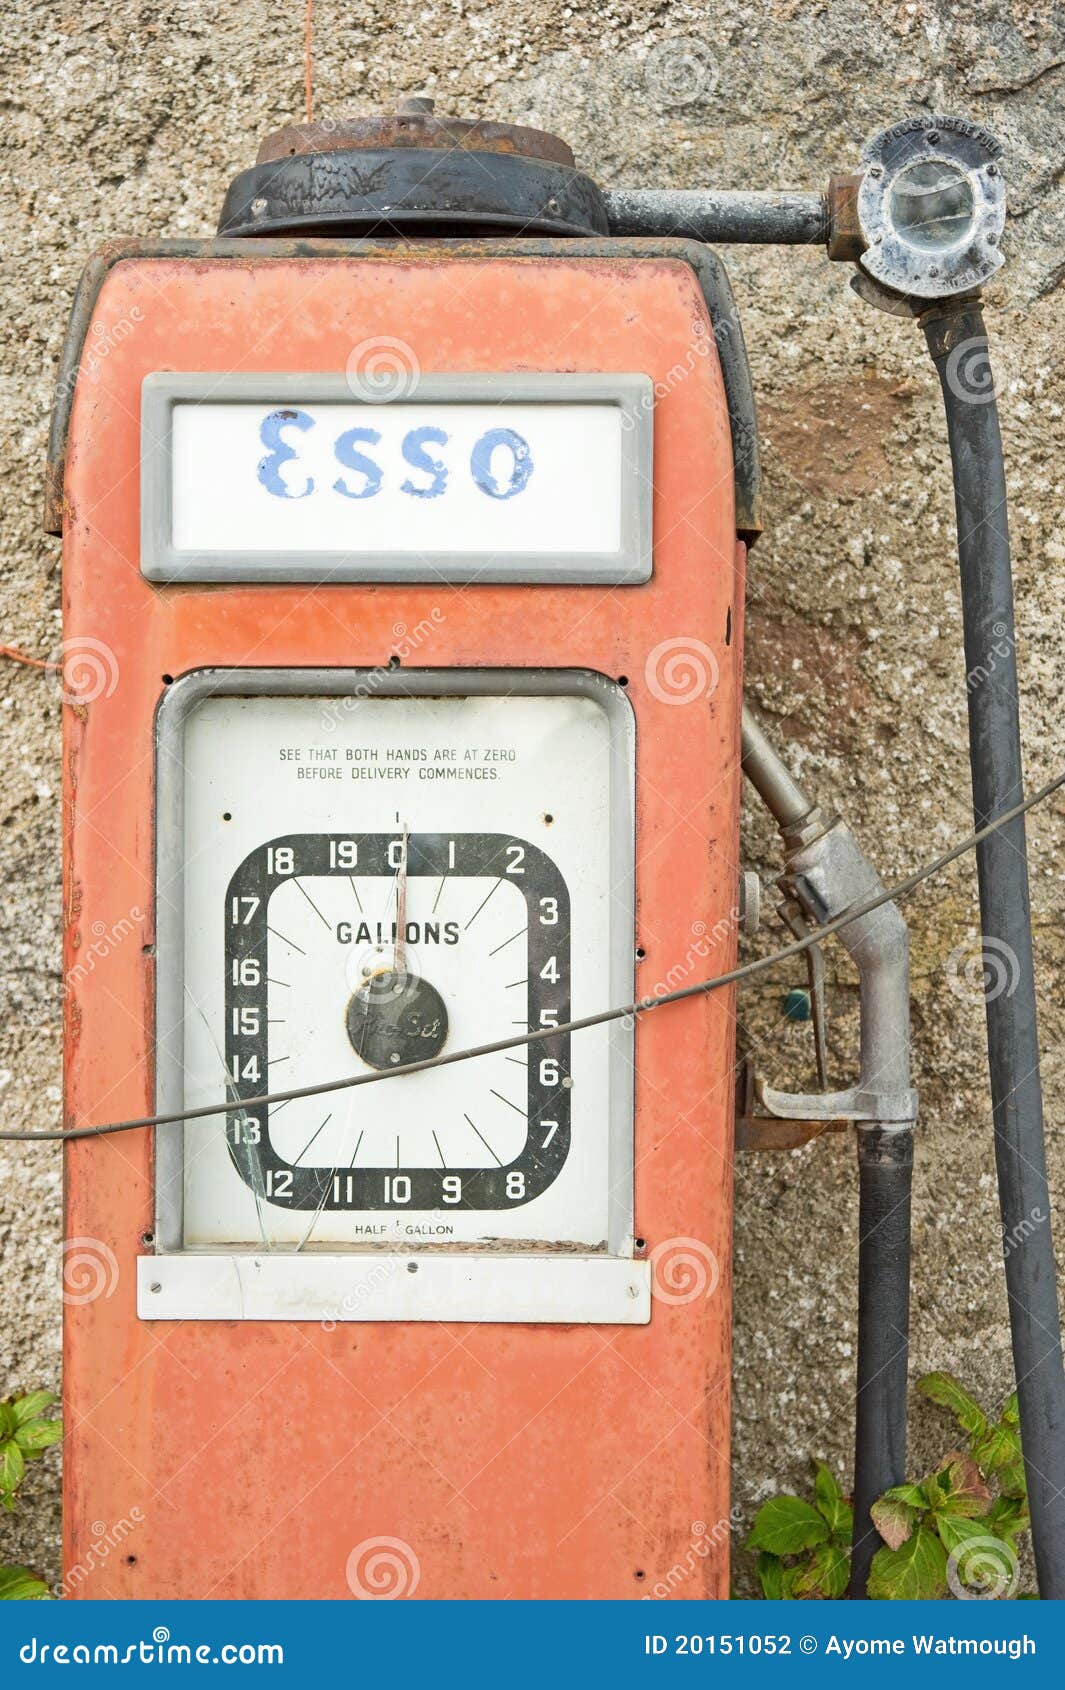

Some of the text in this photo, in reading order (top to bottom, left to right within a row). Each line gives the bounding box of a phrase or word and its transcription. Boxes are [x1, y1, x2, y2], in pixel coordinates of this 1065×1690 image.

[974, 129, 1002, 153] FULL
[279, 748, 516, 761] SEE THAT BOTH HANDS ARE AT ZERO
[297, 767, 501, 780] BEFORE DELIVERY COMMENCES.
[267, 847, 295, 875] 18
[330, 841, 358, 869] 19
[388, 840, 408, 869] 0
[448, 840, 455, 869] 1
[506, 846, 525, 874] 2
[232, 896, 260, 925] 17
[539, 897, 559, 925] 3
[232, 958, 260, 987] 16
[539, 956, 561, 984] 4
[232, 1007, 260, 1036] 15
[539, 1009, 559, 1034] 5
[233, 1056, 261, 1083] 14
[539, 1058, 559, 1087] 6
[234, 1117, 261, 1145] 13
[540, 1120, 559, 1149] 7
[266, 1170, 294, 1198] 12
[333, 1175, 353, 1204] 11
[384, 1175, 412, 1204] 10
[442, 1175, 462, 1204] 9
[506, 1171, 526, 1200] 8
[355, 1225, 454, 1235] HALF GALLON
